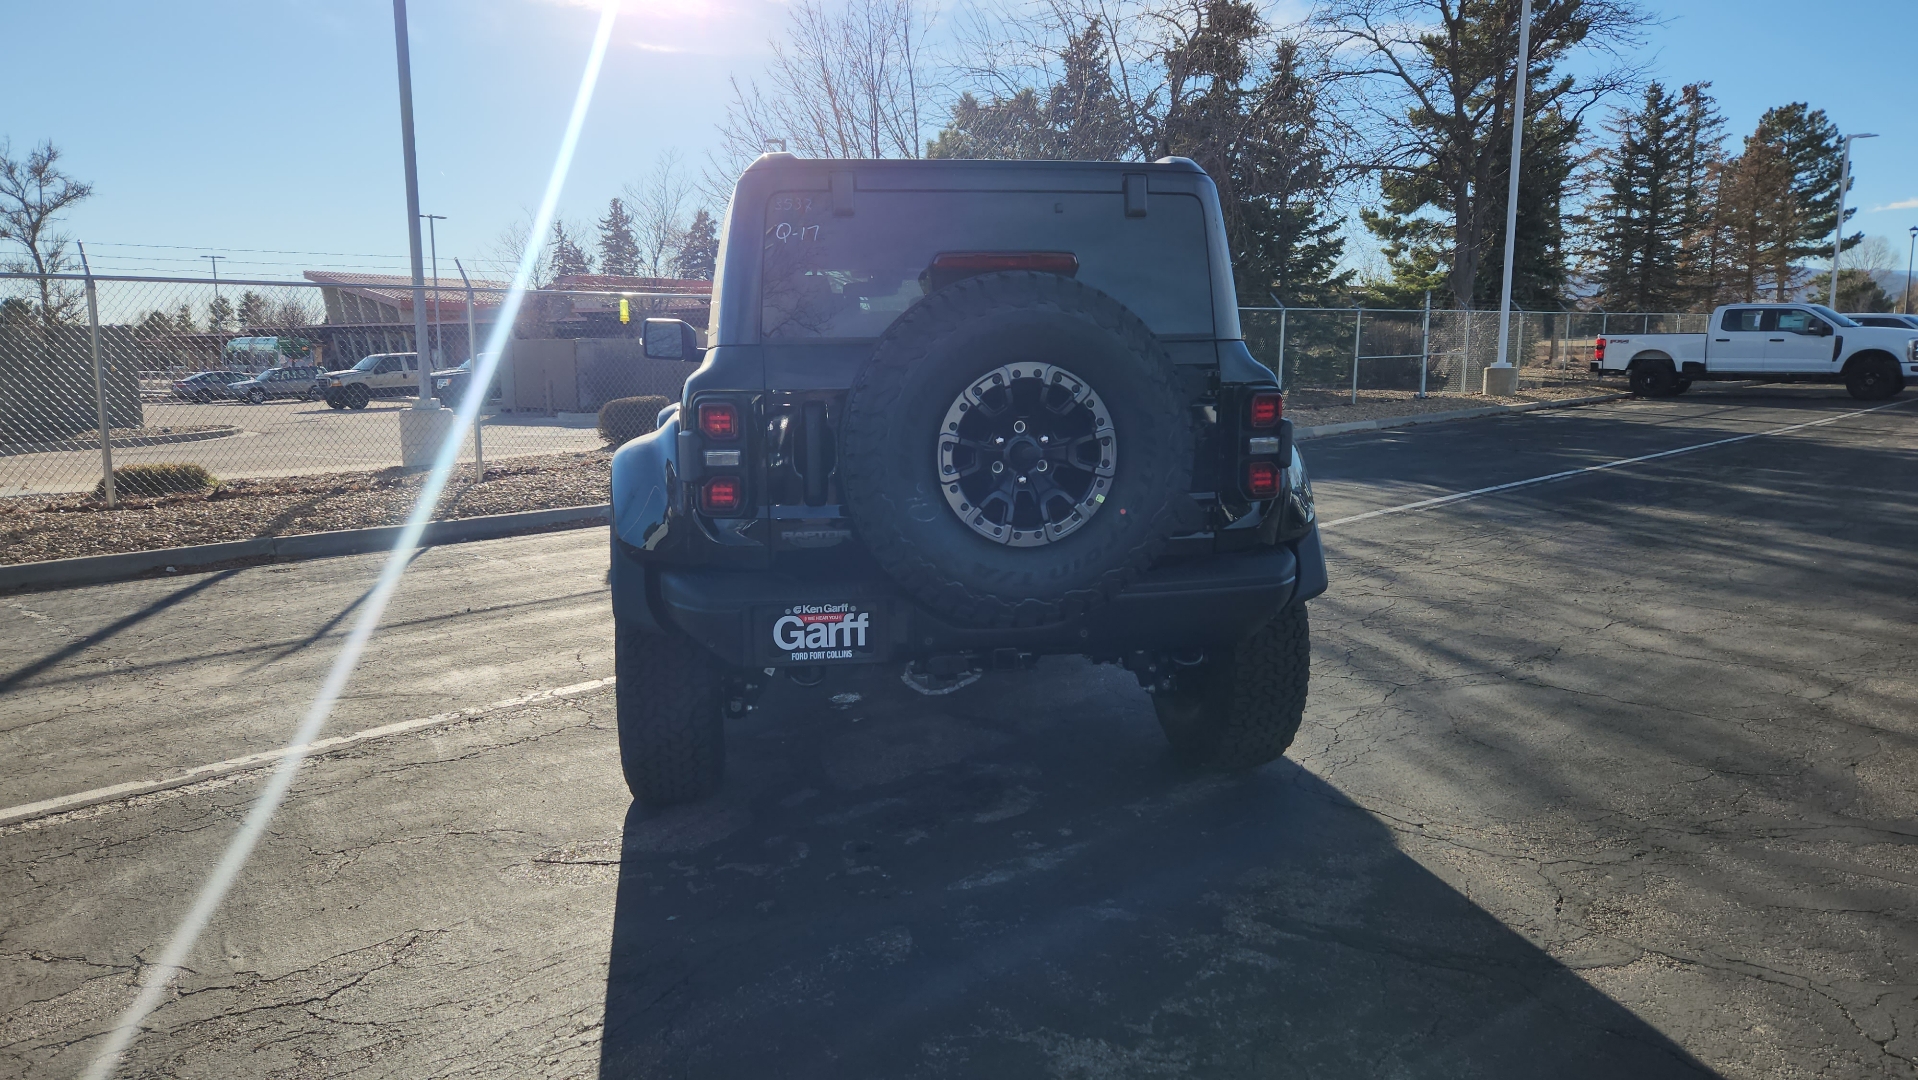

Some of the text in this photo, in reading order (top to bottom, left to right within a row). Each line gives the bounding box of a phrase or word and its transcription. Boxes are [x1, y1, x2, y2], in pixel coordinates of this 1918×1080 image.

[775, 222, 820, 243] Q-17
[781, 530, 853, 541] RAPTOR
[802, 603, 849, 614] Ken Garff
[773, 613, 869, 650] Garff
[791, 650, 853, 661] FORD FORT COLLINS
